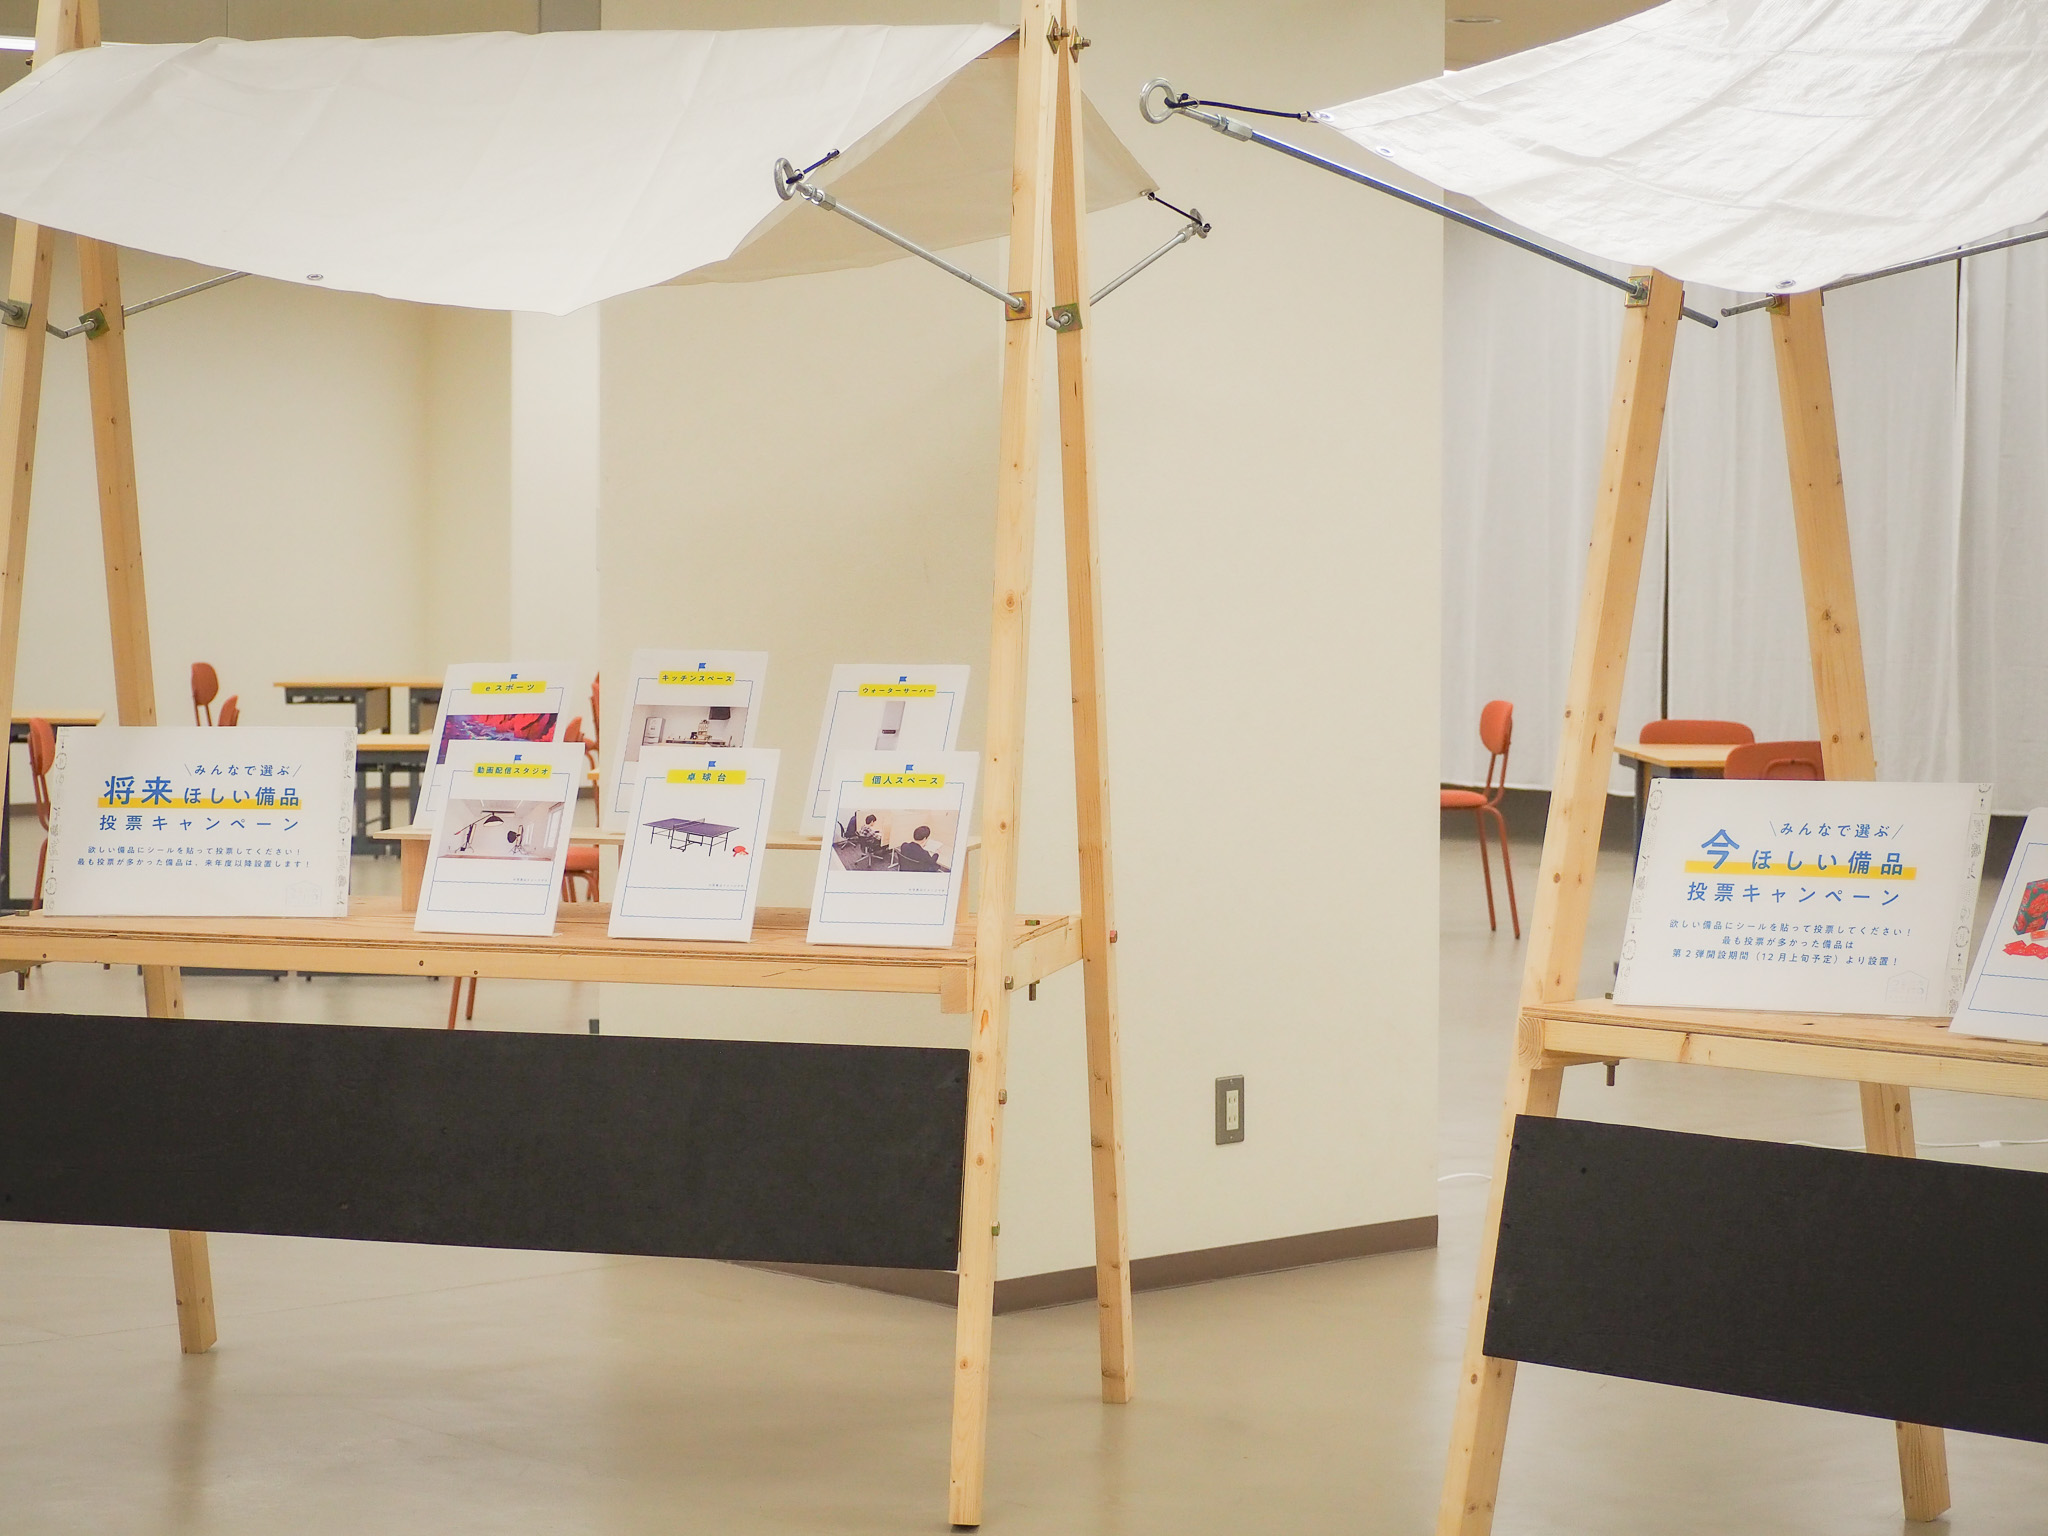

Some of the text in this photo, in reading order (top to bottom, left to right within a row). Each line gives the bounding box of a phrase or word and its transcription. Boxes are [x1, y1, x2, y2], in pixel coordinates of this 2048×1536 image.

[661, 673, 734, 684] キッチンスペース
[476, 765, 549, 776] 動画配信スタジオ
[686, 772, 727, 783] 卓球台
[871, 775, 939, 786] 個人スペース
[103, 775, 300, 807] 将来 ほしい備品
[99, 814, 299, 832] 投票キャンペーン
[1700, 828, 1904, 877] 今 ほしい備品
[1686, 881, 1902, 907] 投票キャンペーン
[1721, 935, 1855, 951] 最も投票が多かった備品は
